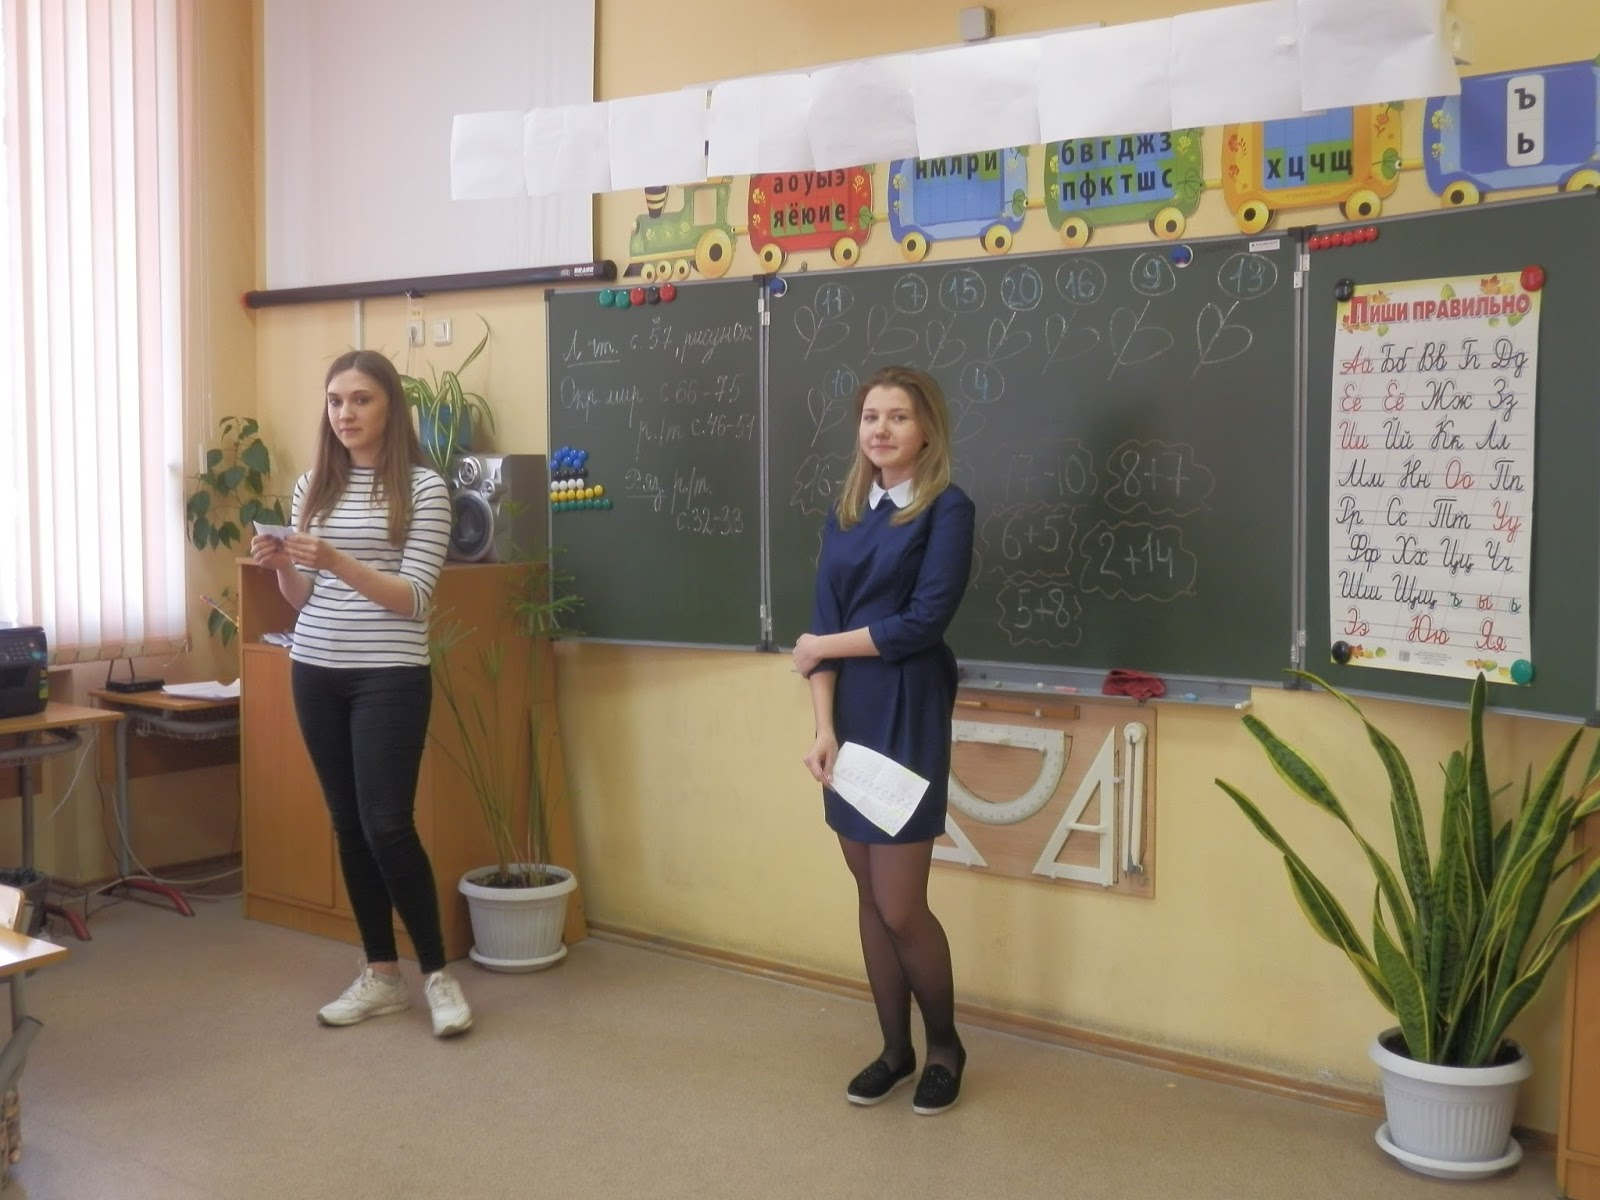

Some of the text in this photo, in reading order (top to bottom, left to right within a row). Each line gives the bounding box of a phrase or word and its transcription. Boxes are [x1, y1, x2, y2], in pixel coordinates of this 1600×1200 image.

[1004, 271, 1037, 306] 20
[1065, 267, 1095, 298] 16
[1141, 258, 1161, 289] 9
[901, 281, 923, 306] 7
[949, 275, 979, 306] 15
[1412, 293, 1531, 321] ПРАВИЛЬНО
[1340, 346, 1375, 375] Аа
[1381, 343, 1414, 373] Бб
[1418, 341, 1448, 373] Вв
[1491, 337, 1529, 378] Дд
[831, 369, 854, 397] 10
[1341, 379, 1519, 421] Ее Ёё Жж Зз
[1338, 417, 1511, 450] Ии Йй Кк Лл
[1338, 459, 1524, 491] Мм Нн Оо Пп
[1336, 496, 1522, 542] Рр Сс Тт Уу
[1347, 533, 1381, 572] Фф
[1392, 535, 1429, 566] Хх
[1440, 537, 1474, 574] Цц
[1338, 570, 1382, 600] Шш
[1392, 574, 1437, 609] Щщ
[1344, 608, 1507, 651] Ээ Юю Яя
